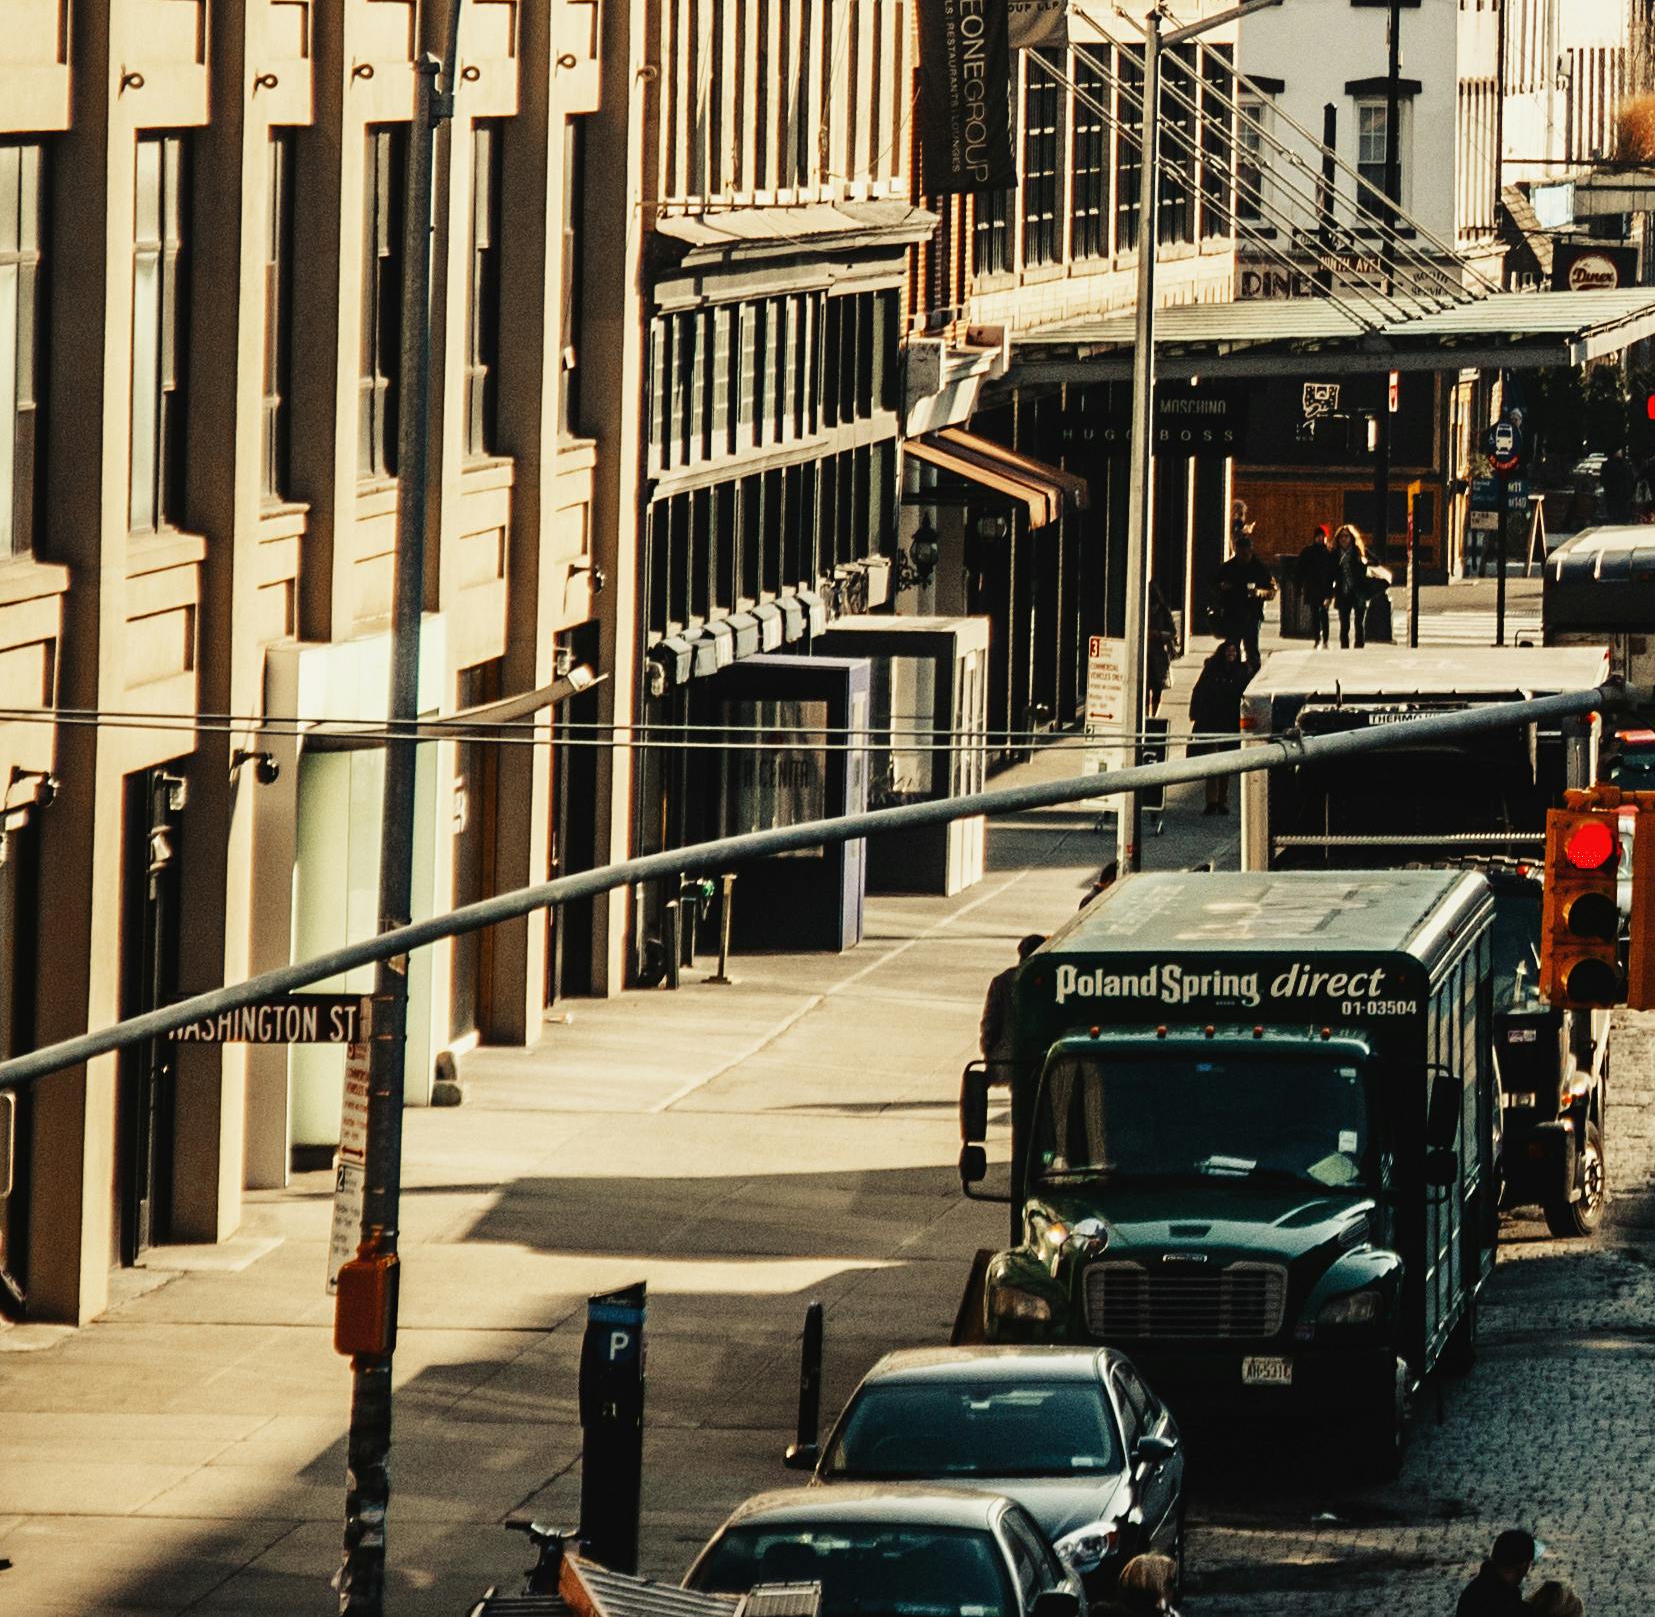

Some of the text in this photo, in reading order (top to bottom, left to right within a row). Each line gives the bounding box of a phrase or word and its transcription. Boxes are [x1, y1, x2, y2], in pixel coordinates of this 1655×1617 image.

[951, 115, 963, 173] LOUNGES
[1160, 399, 1226, 415] MOSCHINO
[1160, 429, 1233, 442] BOSS
[1091, 639, 1099, 657] 3
[1269, 962, 1386, 999] direct
[1341, 999, 1417, 1016] 01-03504
[168, 1005, 357, 1042] ASHINGTON ST
[336, 1164, 346, 1191] 2
[609, 1331, 629, 1361] P
